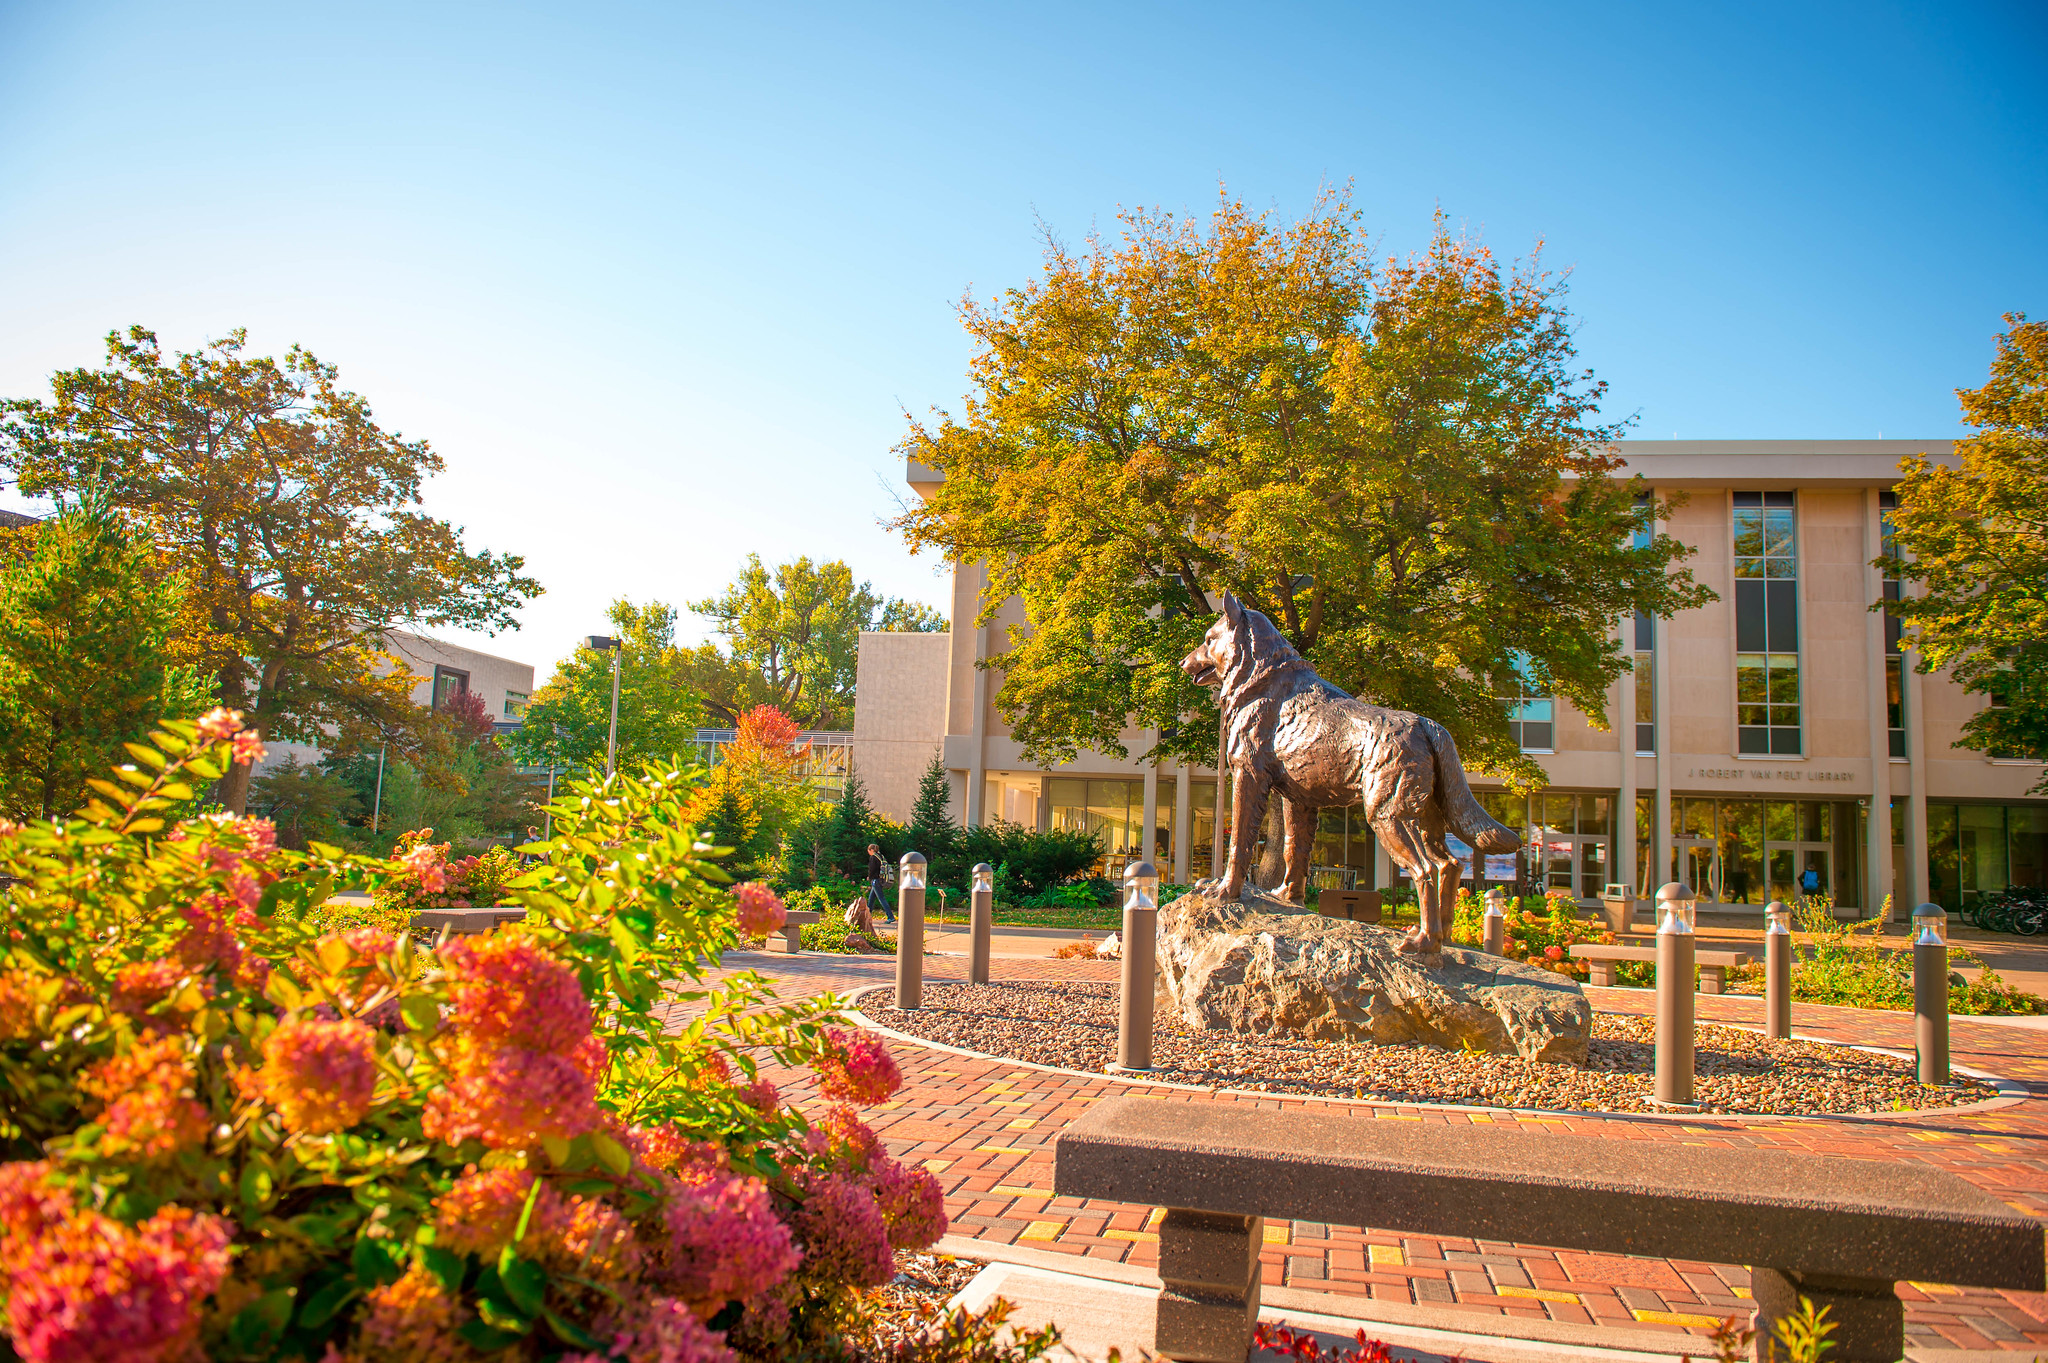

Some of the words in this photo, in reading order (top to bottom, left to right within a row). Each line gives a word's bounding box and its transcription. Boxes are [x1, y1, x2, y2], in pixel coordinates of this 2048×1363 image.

[1687, 768, 1694, 778] J
[1698, 768, 1744, 779] ROBERT
[1750, 769, 1771, 780] VAN
[1776, 770, 1803, 781] PELT
[1808, 771, 1855, 782] LIBRARY
